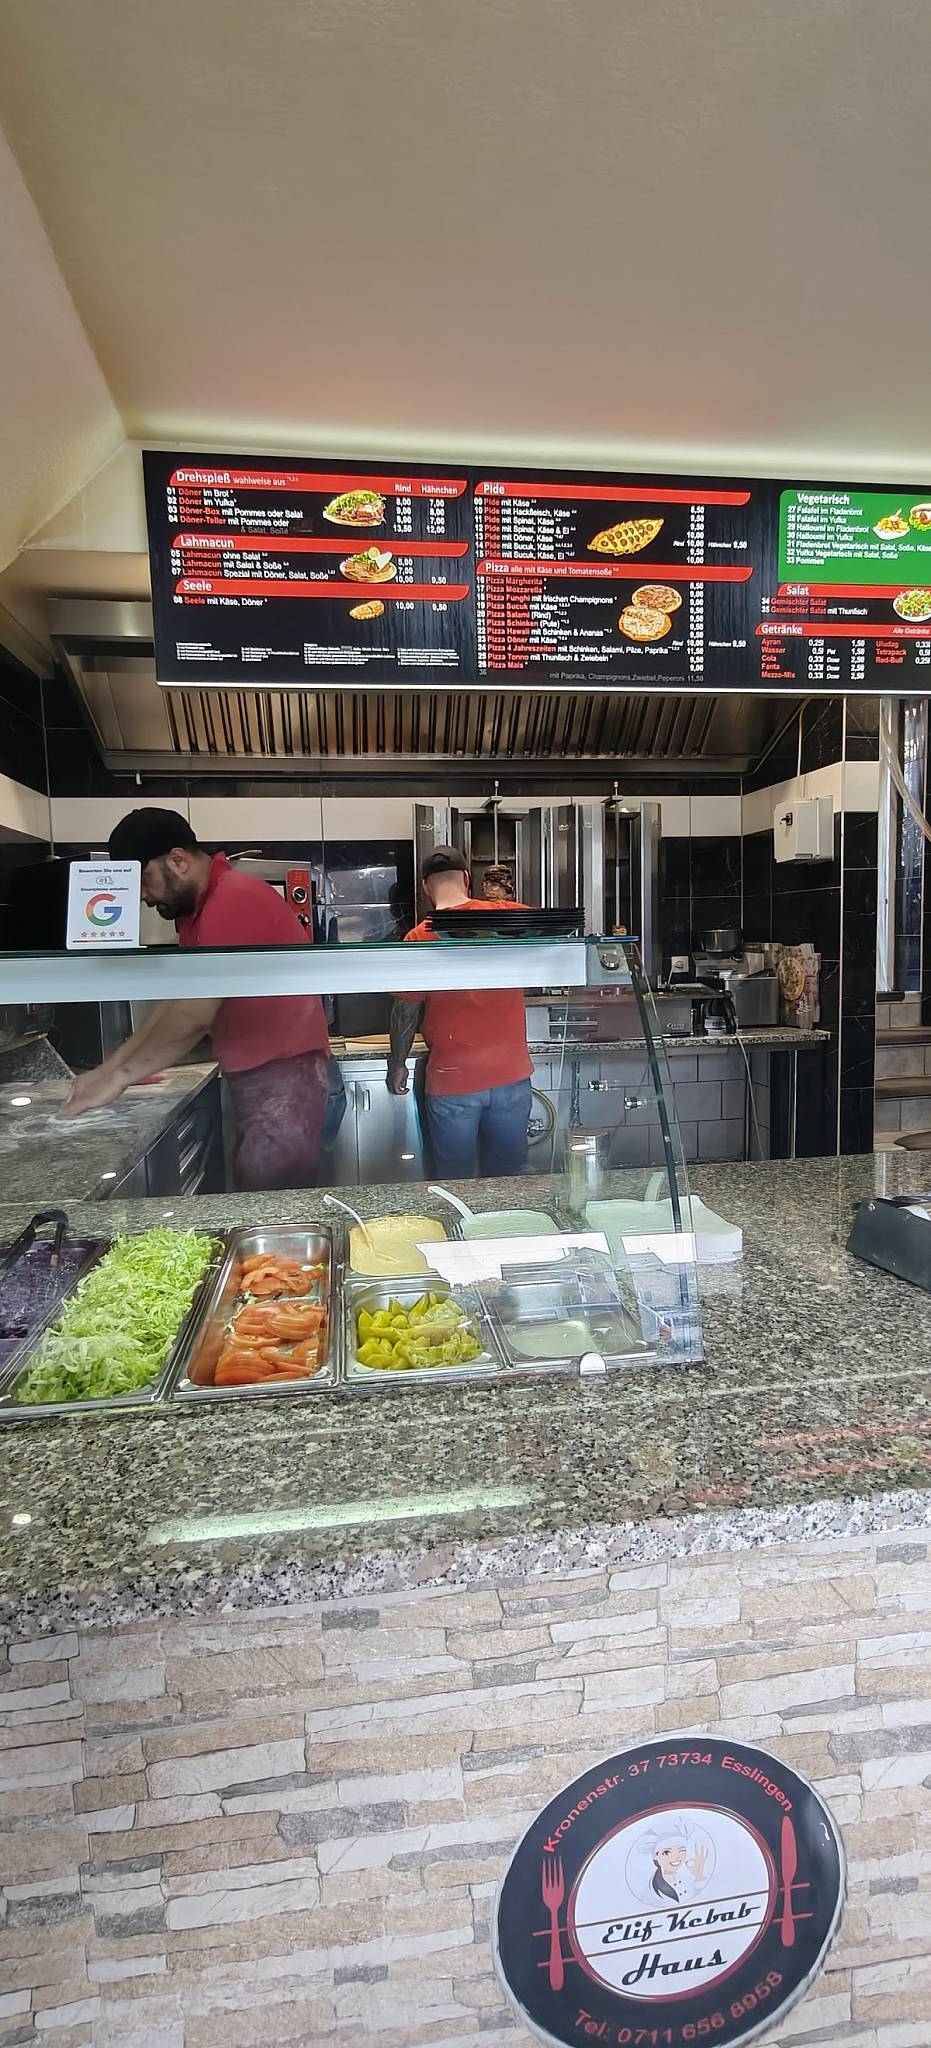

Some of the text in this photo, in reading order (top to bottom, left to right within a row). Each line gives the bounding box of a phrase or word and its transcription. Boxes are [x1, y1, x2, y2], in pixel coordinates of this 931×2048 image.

[176, 471, 230, 484] Drehspieß
[233, 476, 272, 485] wahlweise
[394, 484, 458, 494] Rind Hähnchen
[484, 484, 504, 494] Pide
[430, 499, 444, 508] 7,00
[797, 493, 850, 506] Vegetarisch
[796, 506, 819, 514] Falafel
[830, 508, 862, 516] Fladenbrot
[180, 507, 220, 515] Döner-Box
[234, 509, 266, 517] Pommes
[285, 510, 303, 518] Salat
[430, 517, 444, 526] 7,00
[796, 515, 819, 523] Falafel
[180, 516, 226, 524] Döner-Teller
[228, 518, 239, 526] mit
[241, 518, 272, 526] Pommes
[274, 519, 289, 527] oder
[426, 525, 445, 534] 12,00
[796, 524, 826, 532] Halloumi
[180, 536, 234, 548] Lahmacun
[796, 557, 824, 565] Pommes
[398, 567, 414, 576] 7,00
[486, 563, 508, 572] Pizza
[183, 568, 222, 576] Lahmacun
[224, 570, 250, 579] Spezial
[184, 580, 212, 591] Seele
[486, 576, 542, 586] Pizza Margherita
[786, 586, 809, 595] Salat
[506, 594, 530, 602] Funghi
[570, 596, 613, 605] Champignons
[396, 602, 414, 610] 10,00
[761, 624, 803, 634] Getränke
[762, 638, 898, 648] Ayran Uludag
[86, 894, 122, 926] G
[543, 1752, 793, 1854] Kronenstr. 37 73734 Esslingen
[602, 1902, 760, 1944] Elif Kebab
[622, 1950, 728, 1986] Haus
[575, 1970, 784, 2044] Tel: 0711 656 8958
